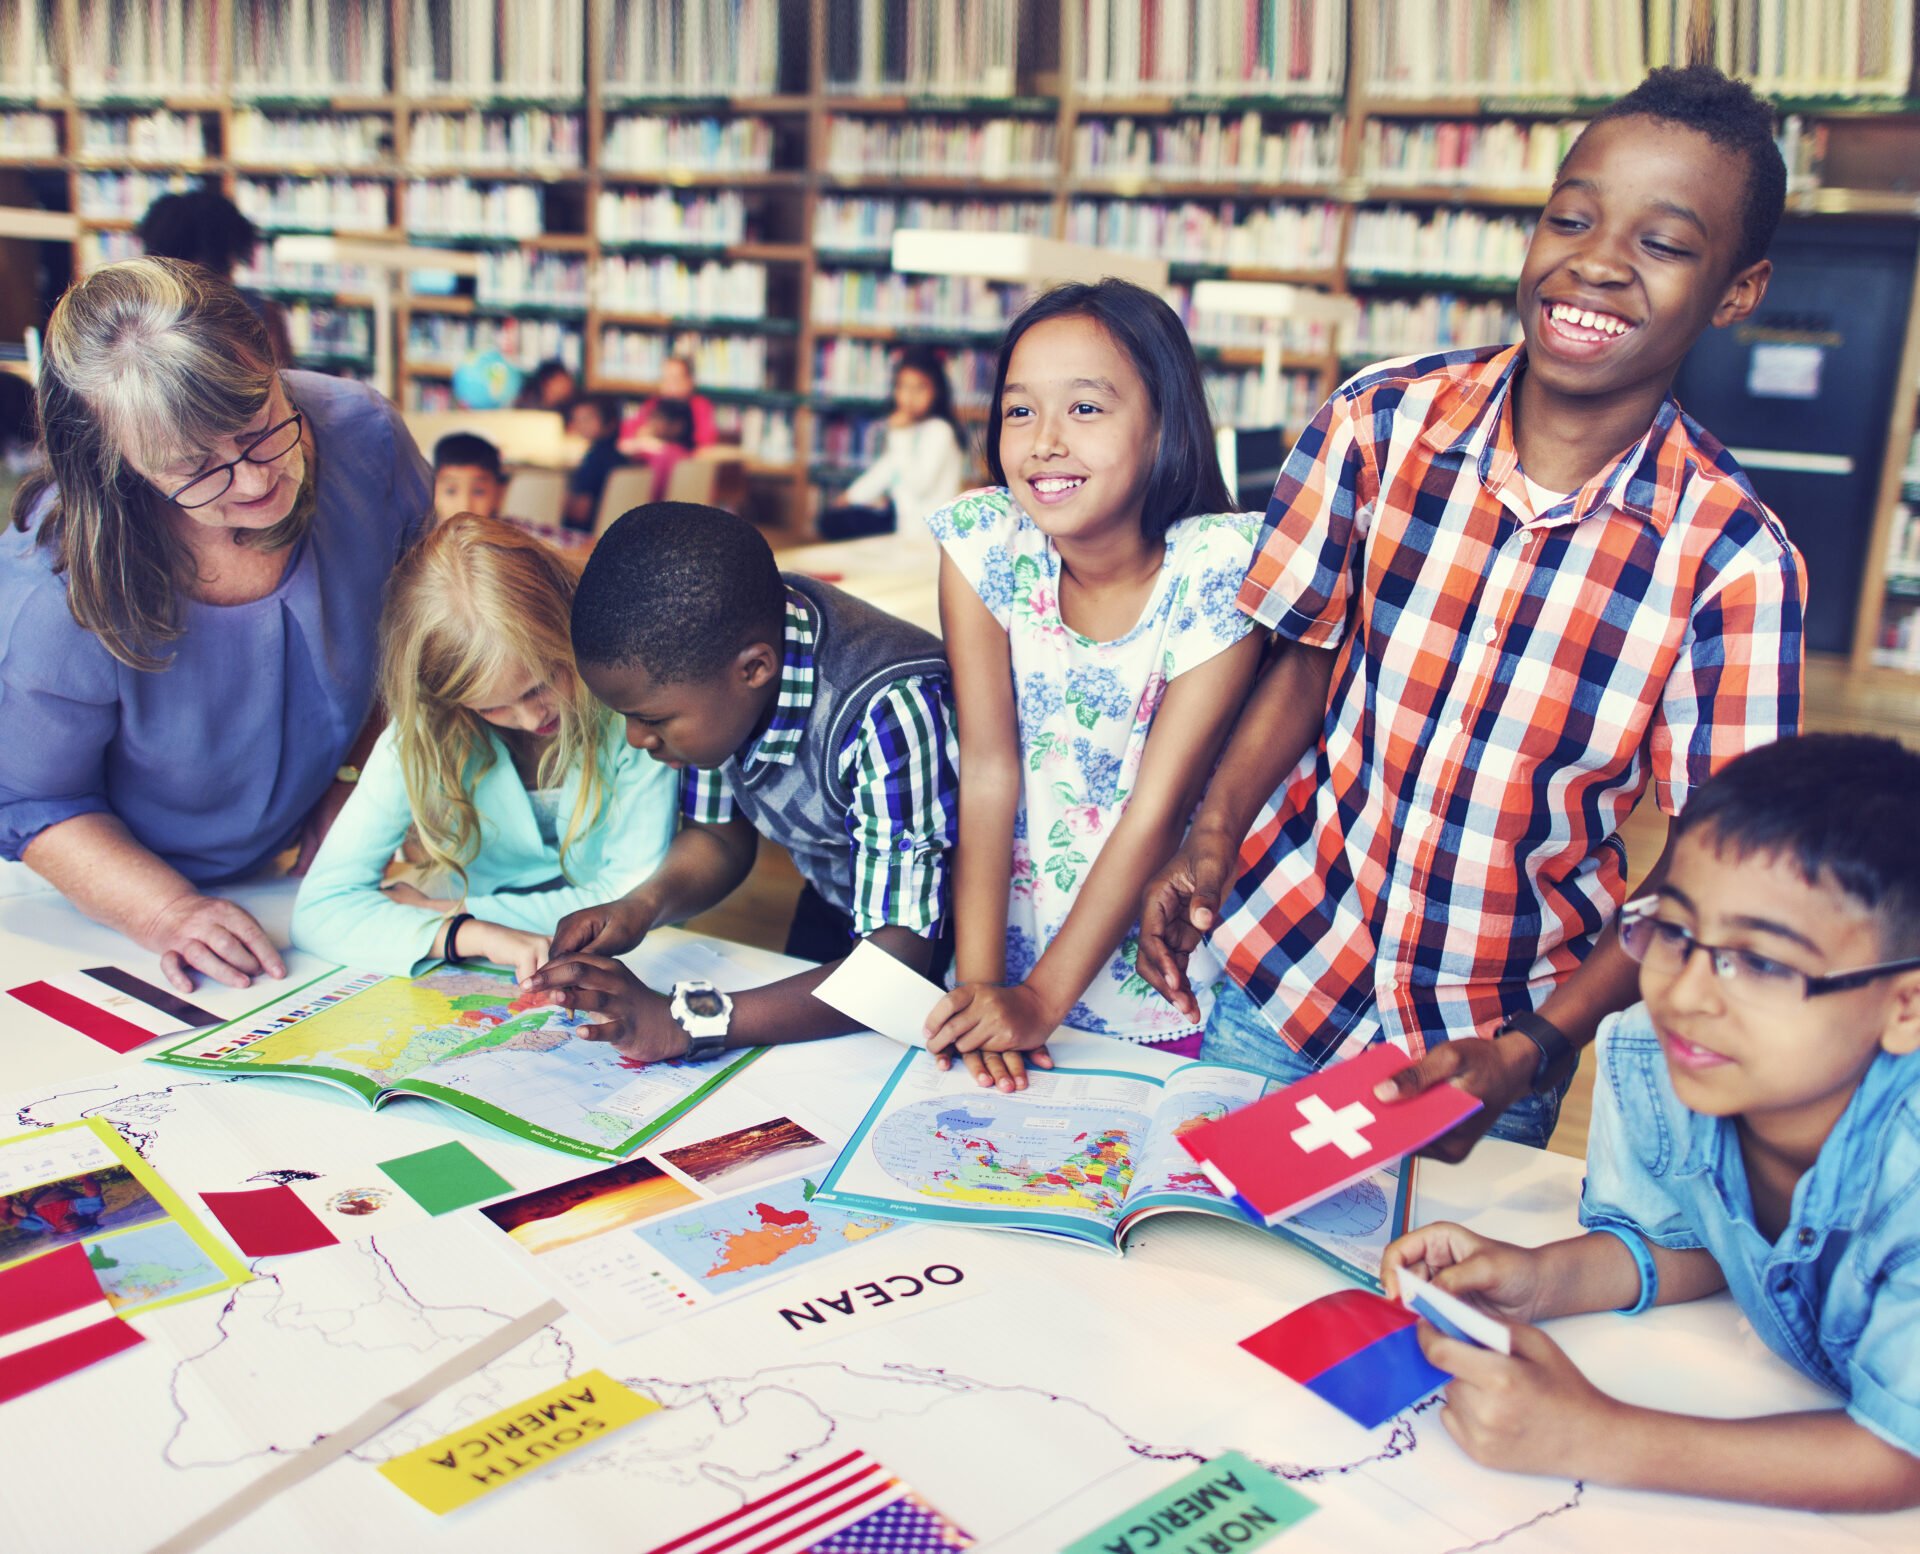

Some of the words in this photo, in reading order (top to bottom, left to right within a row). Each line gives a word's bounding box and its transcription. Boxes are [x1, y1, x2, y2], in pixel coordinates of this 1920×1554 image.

[529, 1129, 558, 1143] Europe
[559, 1140, 595, 1155] Northern
[890, 1203, 918, 1212] World
[1341, 1264, 1370, 1283] World
[778, 1264, 965, 1331] OCEAN
[427, 1387, 597, 1470] AMERICA
[469, 1416, 606, 1484] SOUTH
[1102, 1470, 1247, 1554] AMERICA
